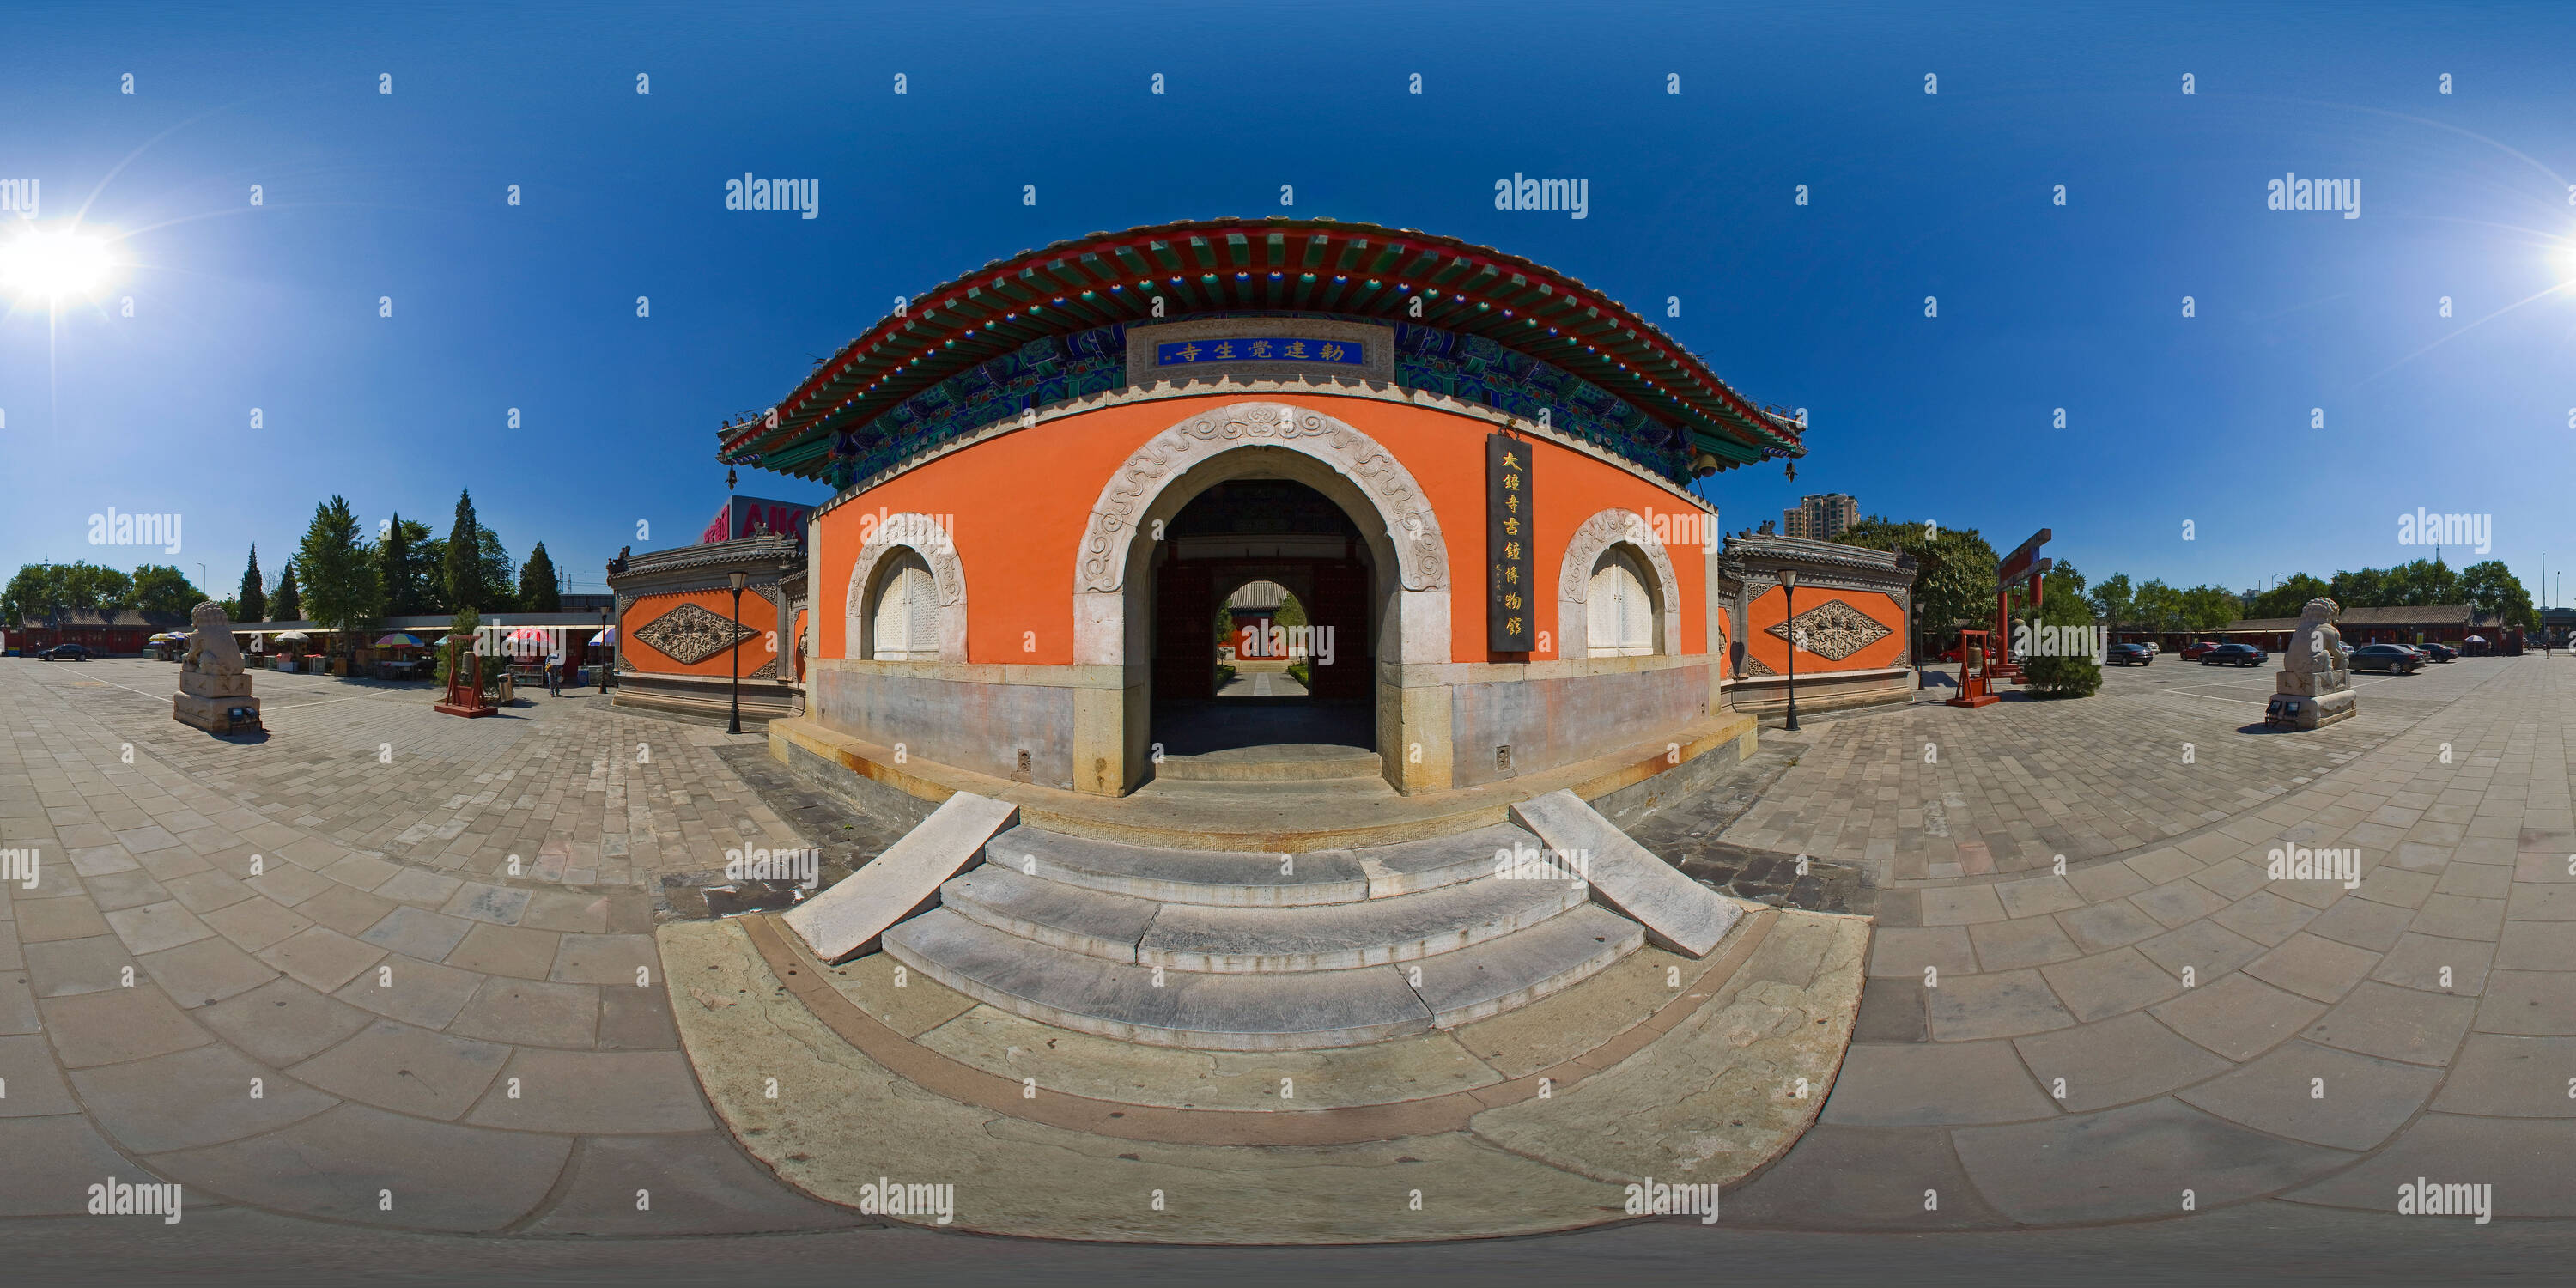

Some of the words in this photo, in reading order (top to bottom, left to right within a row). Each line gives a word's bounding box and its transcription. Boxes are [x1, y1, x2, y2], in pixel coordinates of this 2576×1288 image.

[1502, 452, 1522, 636] 大鐘寺古鐘博物館
